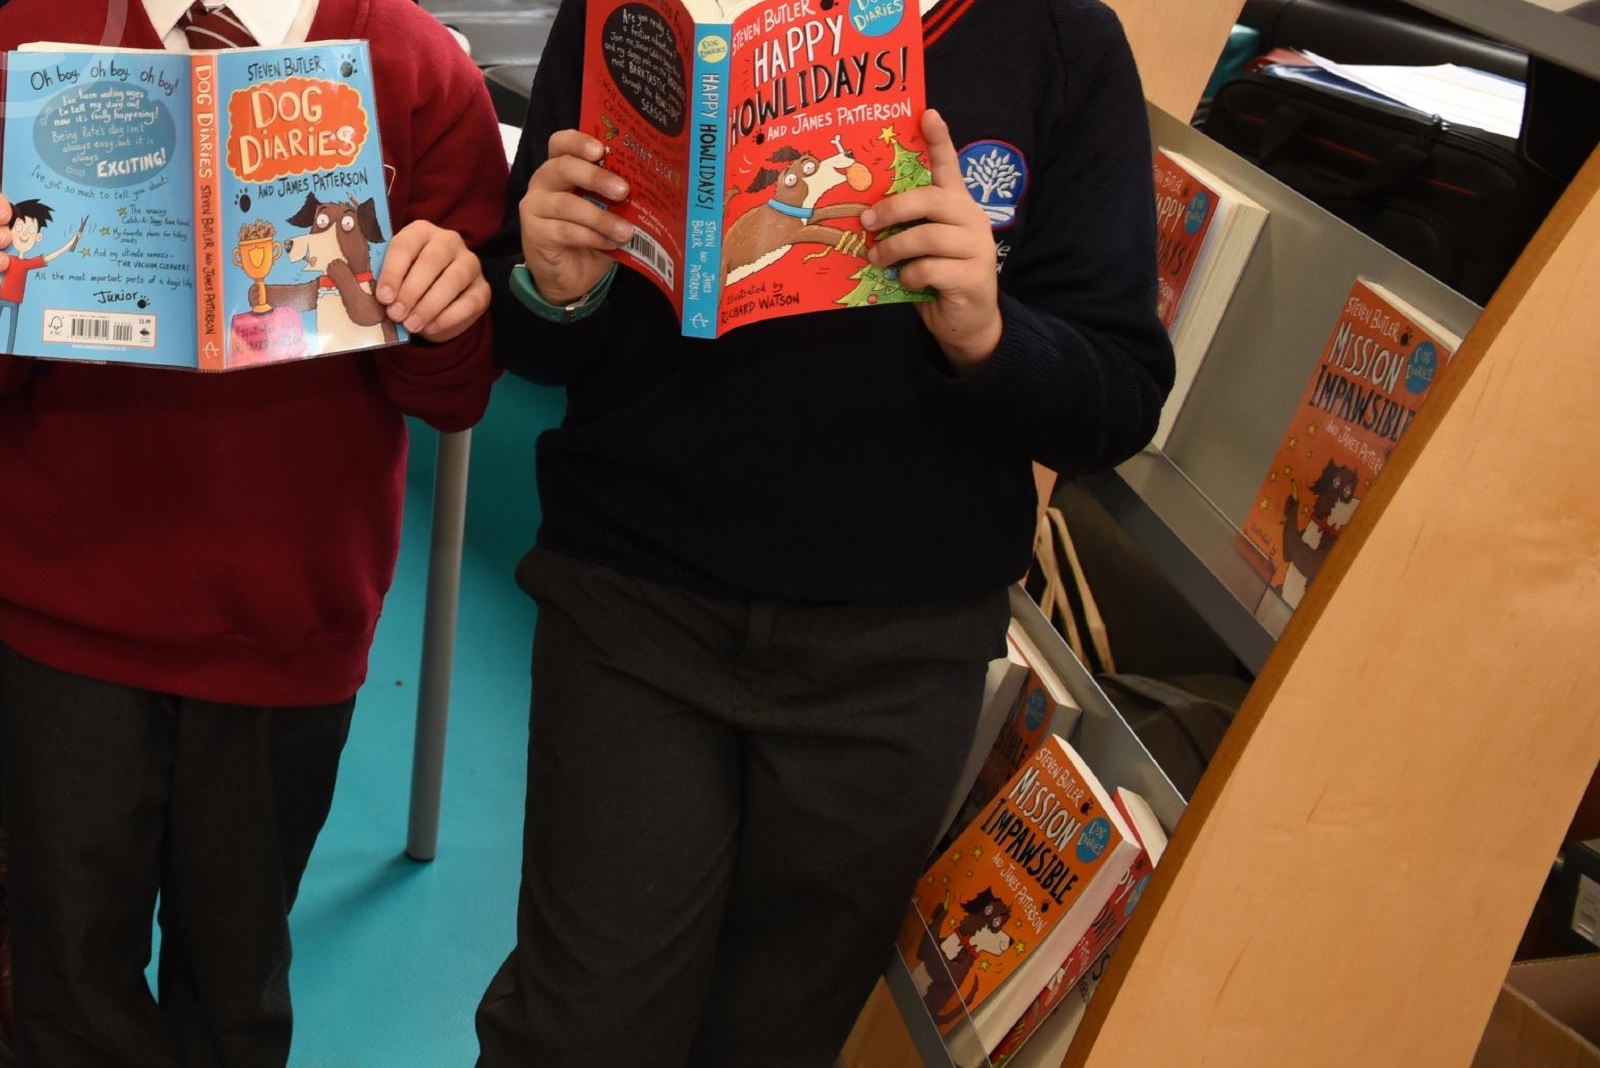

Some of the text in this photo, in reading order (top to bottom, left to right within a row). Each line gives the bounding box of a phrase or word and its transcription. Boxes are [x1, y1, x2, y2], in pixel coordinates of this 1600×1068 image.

[623, 8, 635, 24] Are
[732, 18, 760, 56] STEVEN
[754, 15, 843, 88] HAPPY
[31, 69, 53, 90] Oh
[140, 67, 154, 84] oh
[158, 70, 178, 96] boy!
[247, 55, 325, 81] STEVEN BUTLER
[126, 91, 144, 100] ages
[195, 64, 212, 105] DOG
[727, 46, 908, 153] HOWLIDAYS!
[59, 108, 69, 116] to
[71, 105, 86, 114] tell
[90, 102, 102, 111] my
[114, 107, 159, 125] happening!
[252, 86, 322, 129] DOG
[767, 97, 912, 142] AND JAMES PATTERSON
[52, 131, 78, 143] Being
[696, 74, 719, 210] HAPPY HOWLIDAYS!
[97, 148, 167, 177] EXCITING!
[114, 190, 128, 198] tell
[258, 168, 368, 199] AND JAMES PATTERSON
[201, 185, 211, 214] STEVEN
[202, 219, 213, 250] BUTLER
[93, 289, 137, 304] Junior
[758, 292, 799, 309] WATSON
[1346, 297, 1400, 342] STEVEN BUTLER
[1328, 321, 1405, 394] MISSION
[1036, 747, 1084, 808] STEVEN BUTLER
[1009, 766, 1082, 852] MISSION
[980, 797, 1079, 906] IMPAWSIBLE
[1000, 863, 1048, 934] JAMES PATTERSON
